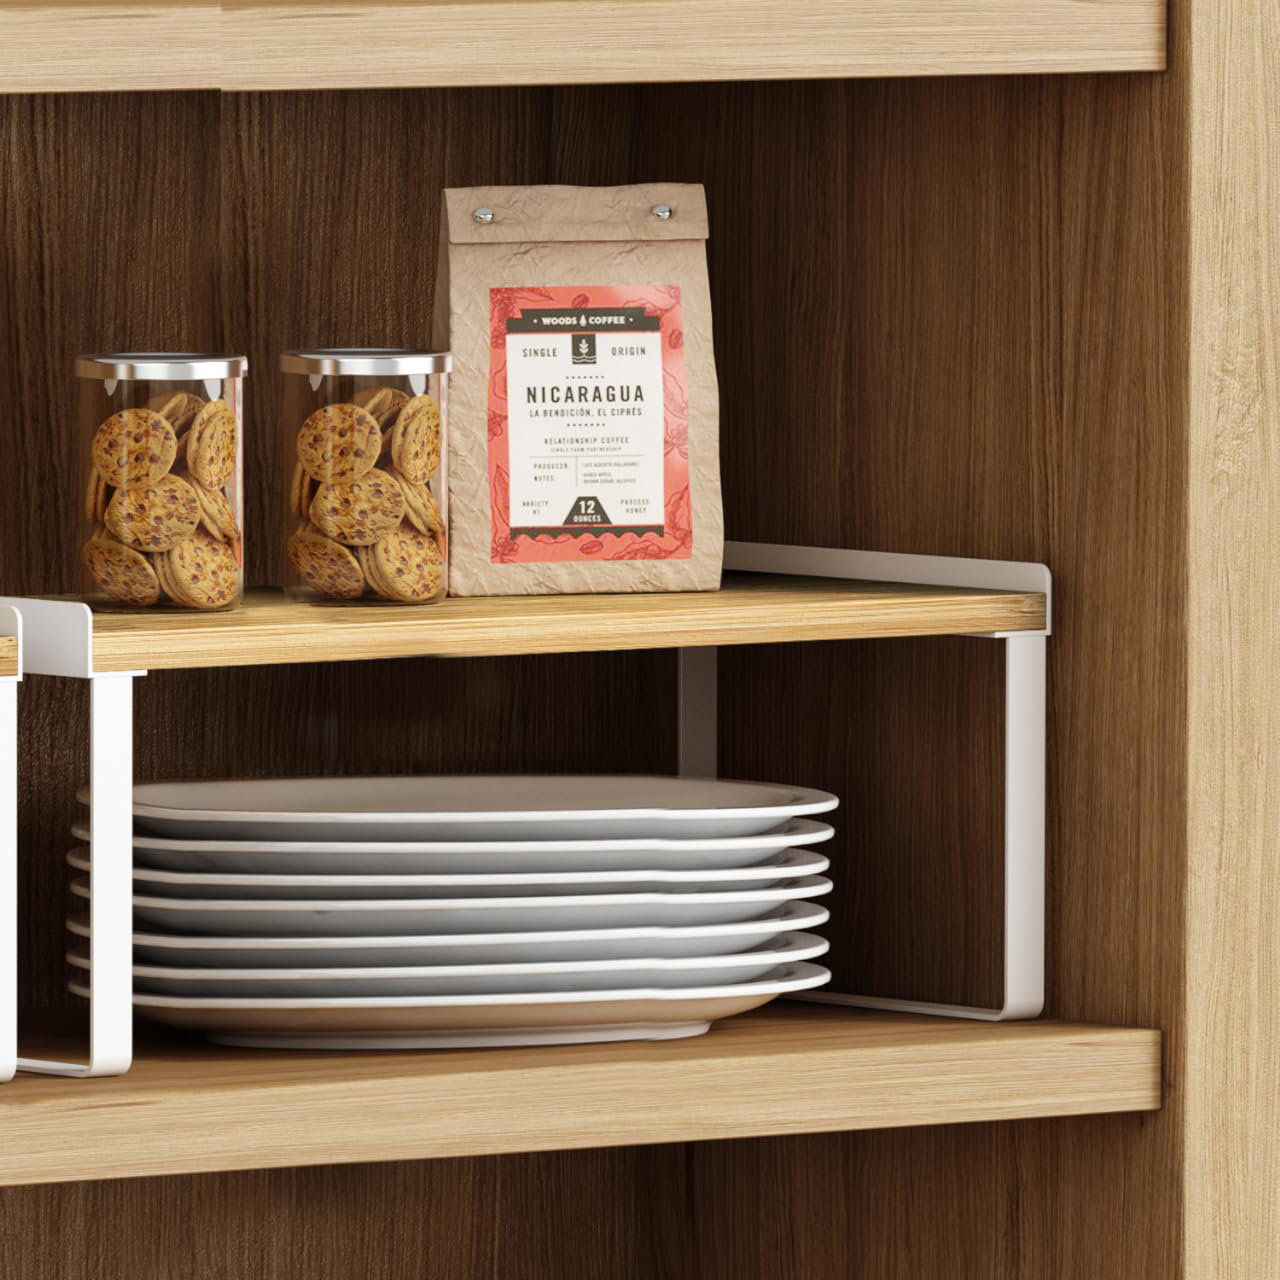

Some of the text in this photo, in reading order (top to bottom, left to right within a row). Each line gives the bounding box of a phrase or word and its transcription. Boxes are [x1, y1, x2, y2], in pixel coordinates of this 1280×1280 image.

[541, 316, 626, 326] WOODS COFFEE
[522, 346, 647, 357] SINGLE ORIGIN
[526, 385, 645, 403] NICARAGUA
[529, 410, 540, 418] LA
[597, 408, 607, 417] EL
[601, 436, 629, 444] COFFEE
[579, 500, 596, 514] 12
[573, 515, 601, 523] OUNCES
